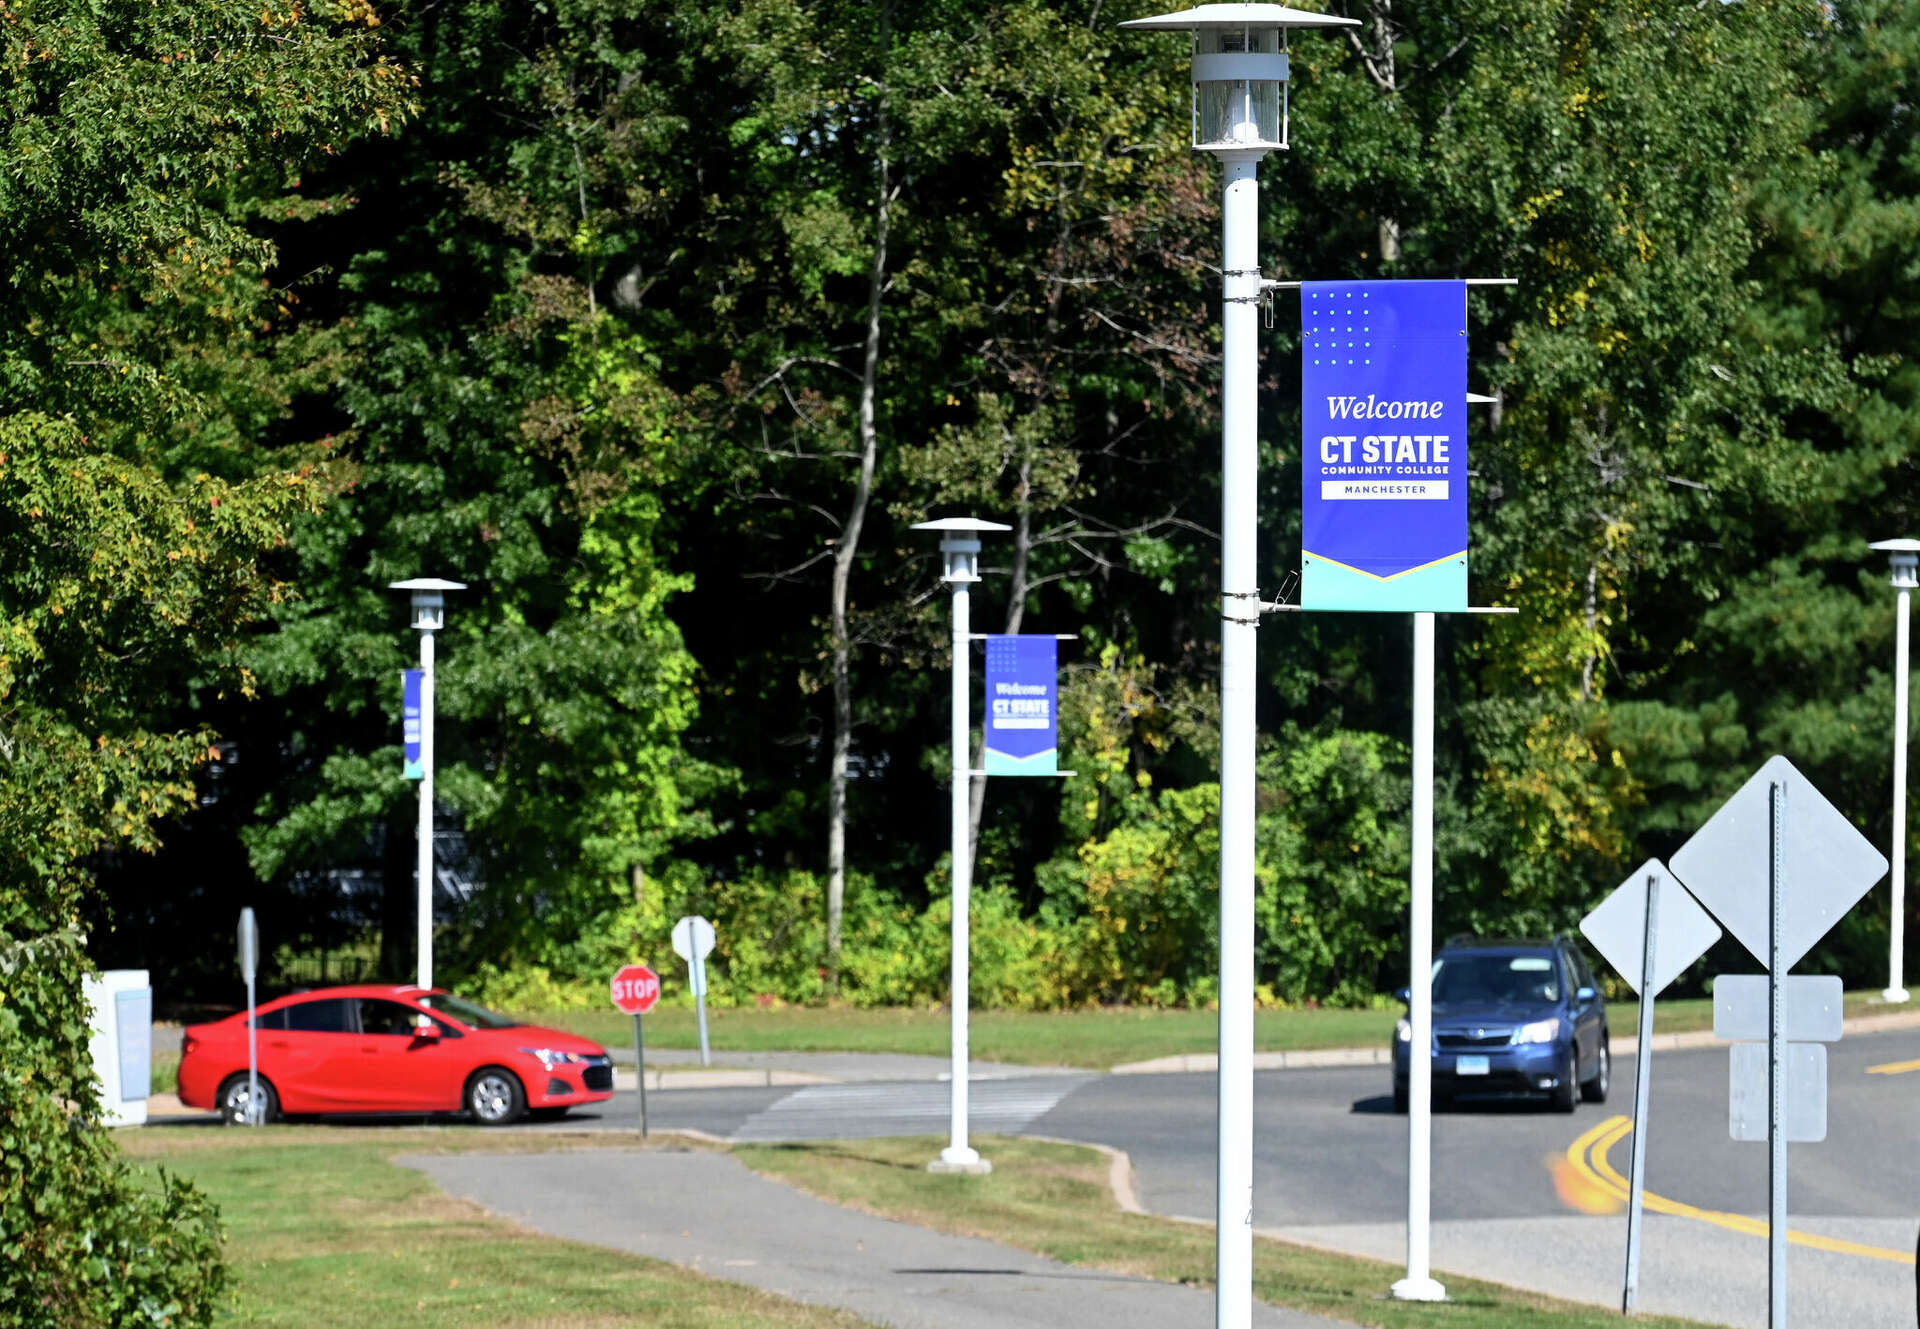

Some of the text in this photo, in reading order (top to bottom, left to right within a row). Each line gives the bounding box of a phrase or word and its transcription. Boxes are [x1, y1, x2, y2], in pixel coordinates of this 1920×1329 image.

[1327, 394, 1443, 419] Welcome
[1320, 435, 1449, 464] CT STATE
[1321, 466, 1449, 475] COMMUNITY COLLEGE
[1345, 486, 1426, 494] MANCHESTER
[996, 682, 1047, 695] Welcome
[992, 699, 1049, 713] CT STATE
[612, 979, 657, 1000] STOP
